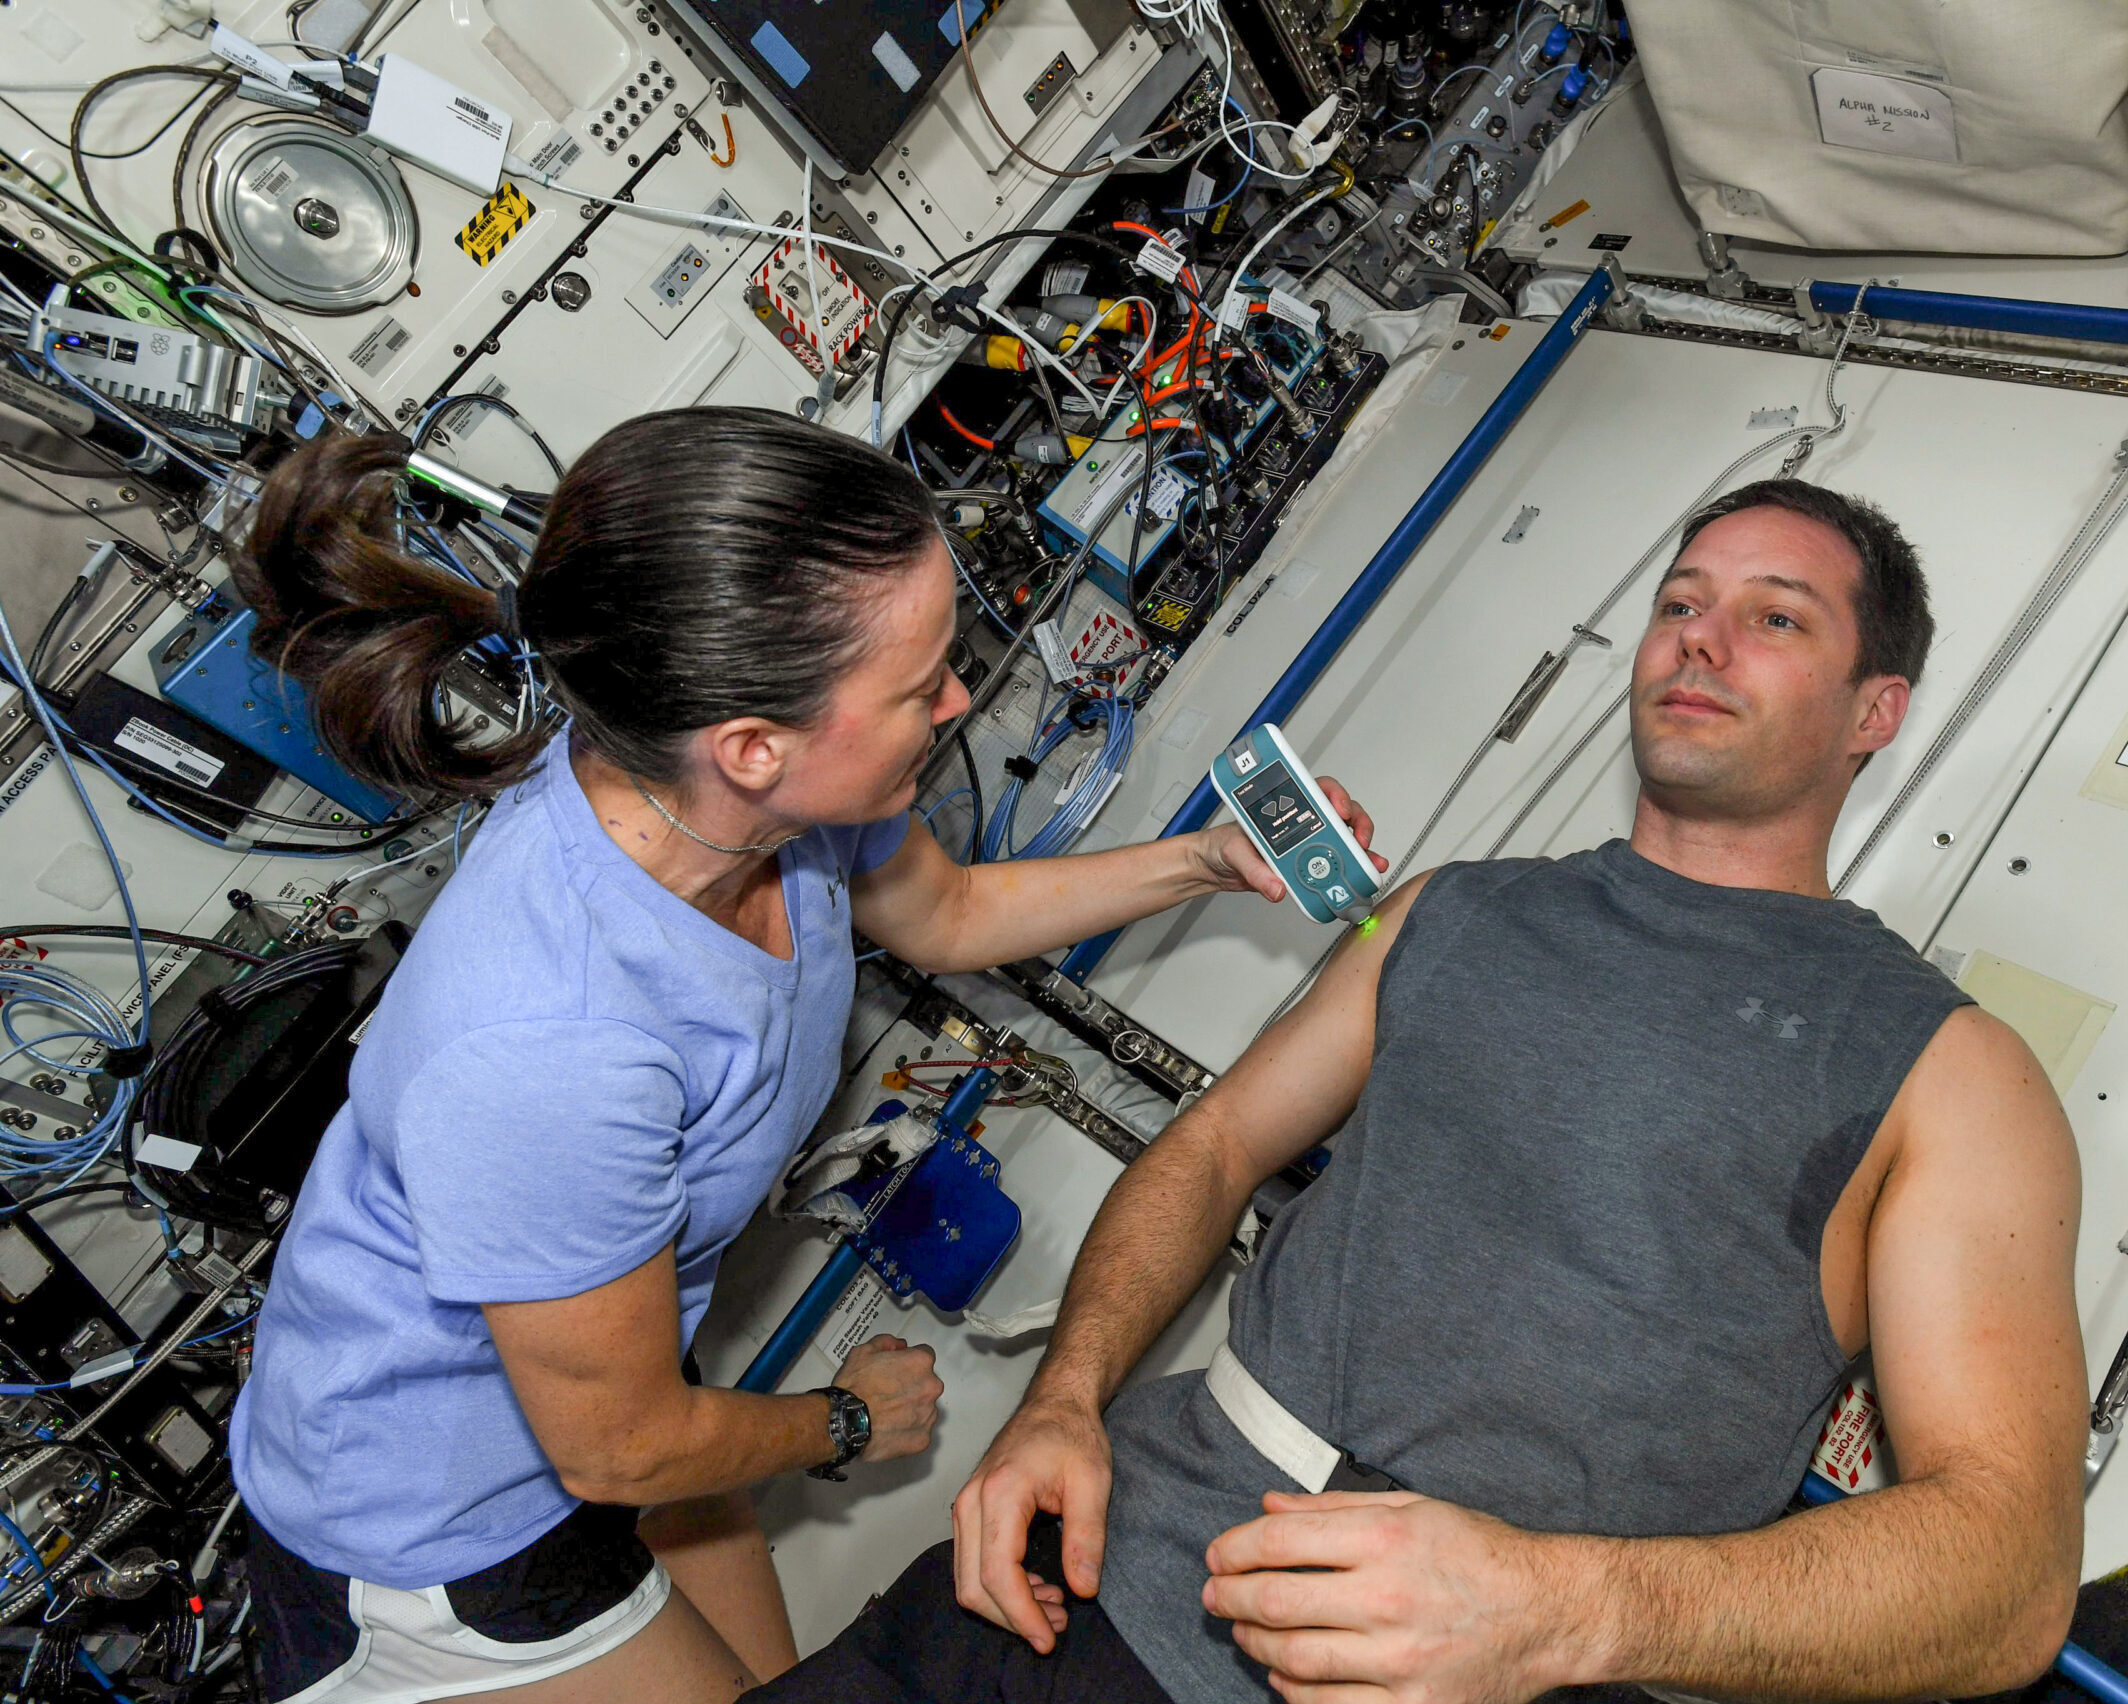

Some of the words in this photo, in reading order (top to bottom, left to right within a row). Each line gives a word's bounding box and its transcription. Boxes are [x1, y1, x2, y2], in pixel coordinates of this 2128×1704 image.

[244, 54, 258, 64] P2
[1839, 97, 1876, 113] ALPHA
[1883, 105, 1930, 121] MISSION
[531, 151, 543, 163] Main
[540, 140, 553, 153] Door
[544, 143, 560, 160] Screws
[466, 214, 495, 243] WARNING
[475, 223, 499, 247] ELECTRICAL
[483, 230, 500, 248] HAZARD
[797, 259, 808, 270] ON
[821, 286, 831, 296] OFF
[825, 297, 840, 313] SMOKE
[829, 293, 853, 318] INDICATION
[826, 332, 846, 351] RACK
[841, 308, 867, 334] POWER
[1097, 459, 1110, 473] POWER
[1074, 636, 1101, 669] ERGENCY
[1097, 623, 1110, 637] USE
[1100, 633, 1124, 660] PORT
[121, 729, 131, 737] S/N
[125, 725, 135, 733] P/N
[130, 717, 148, 729] ZBook
[149, 727, 166, 738] Power
[166, 735, 181, 746] Cable
[181, 743, 194, 753] (DC)
[1239, 757, 1250, 767] J1
[0, 758, 43, 806] ACCESS
[306, 794, 327, 818] SERVICE
[1309, 821, 1322, 831] Cancel
[1310, 859, 1322, 870] ON
[1315, 866, 1327, 875] NEXT
[277, 881, 293, 899] VIDEO
[284, 886, 297, 899] UNIT
[944, 1043, 953, 1053] A2
[882, 1177, 900, 1198] LATCH
[844, 1296, 858, 1313] SOFT
[856, 1281, 869, 1296] BAG
[832, 1338, 845, 1354] FDIR
[843, 1314, 863, 1338] Stepper
[859, 1297, 874, 1314] Valve
[835, 1342, 849, 1358] FDIR
[847, 1324, 863, 1343] Brush
[860, 1307, 875, 1324] Valve
[872, 1294, 883, 1307] tool
[853, 1324, 870, 1344] Labels
[871, 1311, 879, 1319] 40
[1848, 1404, 1870, 1432] FIRE
[1829, 1430, 1854, 1464] PORT
[1842, 1453, 1854, 1468] USE
